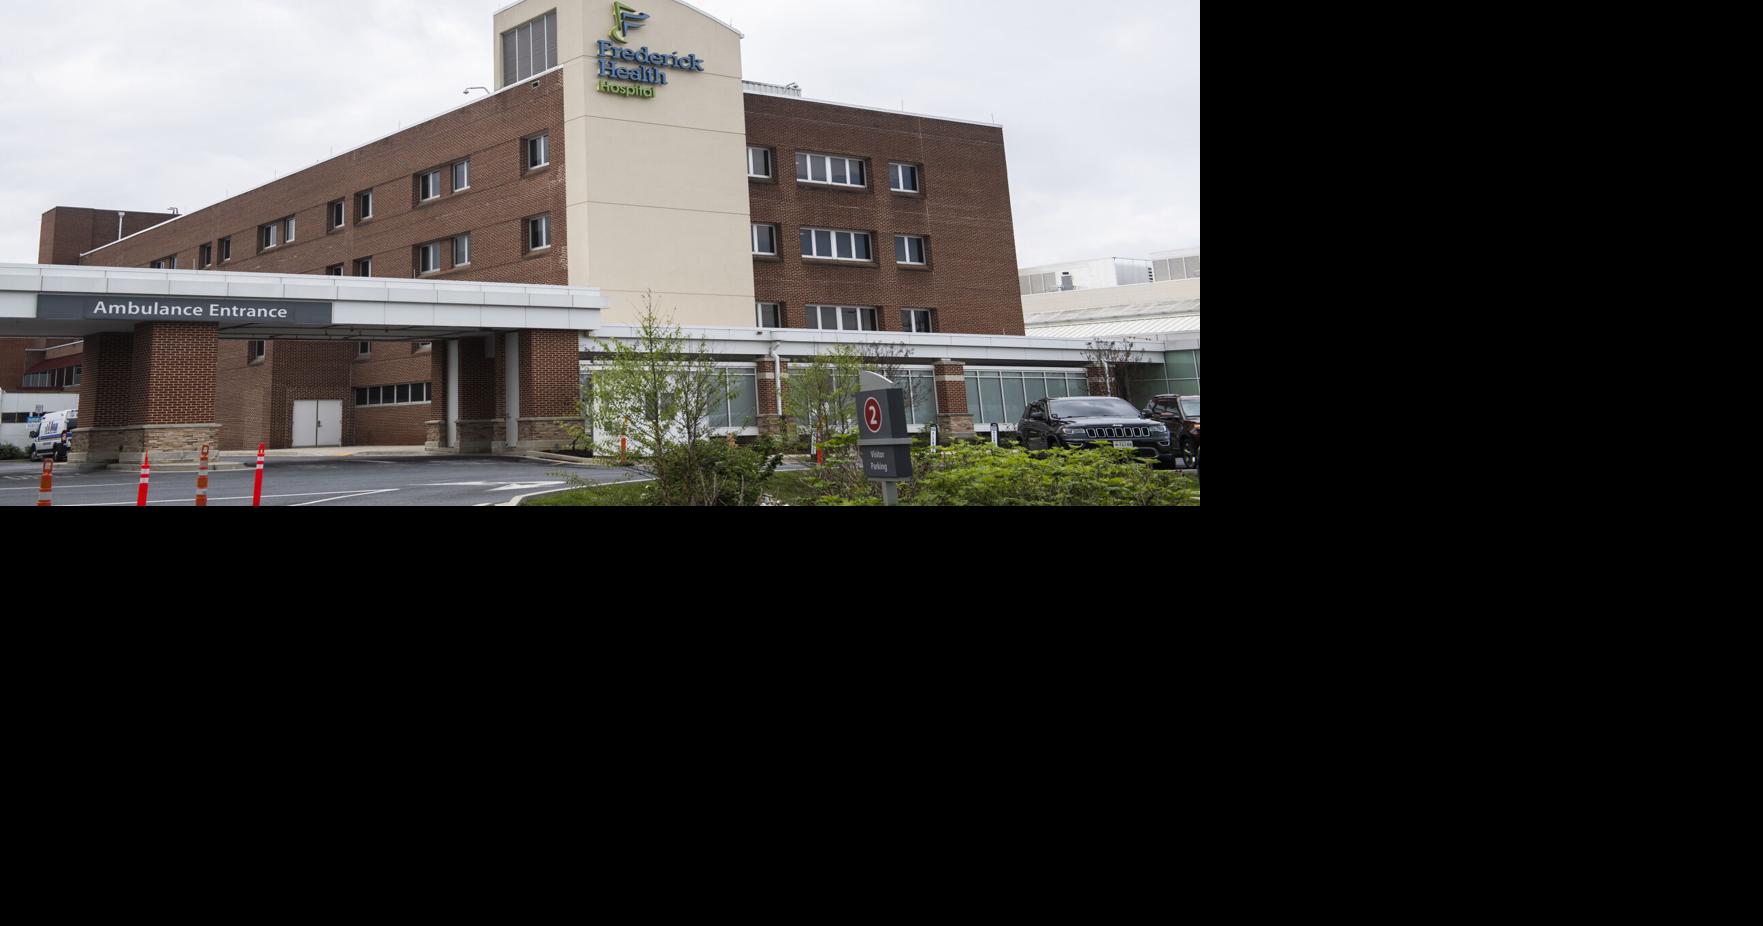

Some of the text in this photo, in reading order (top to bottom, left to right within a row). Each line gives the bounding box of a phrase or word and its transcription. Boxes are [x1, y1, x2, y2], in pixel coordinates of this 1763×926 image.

[597, 40, 704, 71] Frederick
[598, 59, 668, 85] Health
[597, 80, 656, 98] Hospital
[93, 301, 288, 318] Ambulance Entrance
[869, 405, 878, 425] 2
[870, 450, 885, 458] Visitor
[870, 462, 888, 472] Parking
